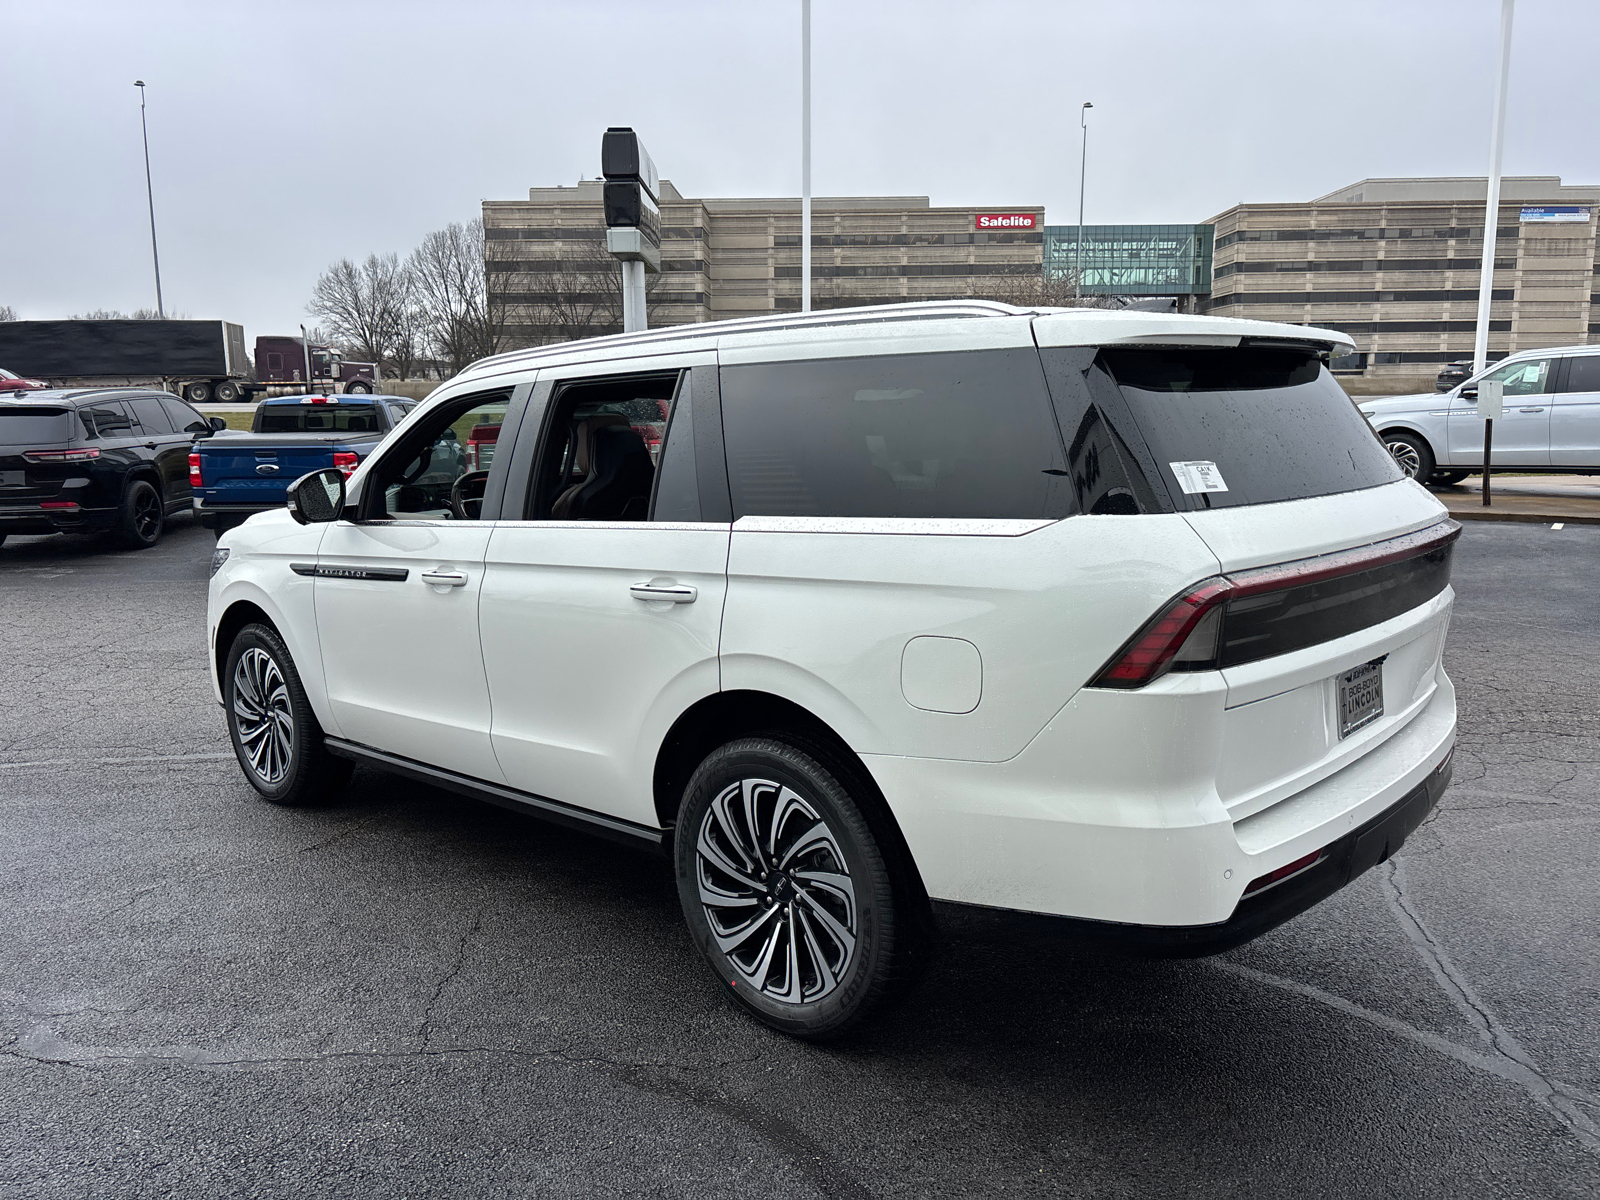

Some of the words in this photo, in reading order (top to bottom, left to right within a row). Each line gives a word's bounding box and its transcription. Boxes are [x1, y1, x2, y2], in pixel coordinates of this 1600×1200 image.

[980, 216, 1032, 227] Safelite
[319, 569, 367, 577] NAVIGATOR
[1348, 685, 1380, 714] LINCOLN
